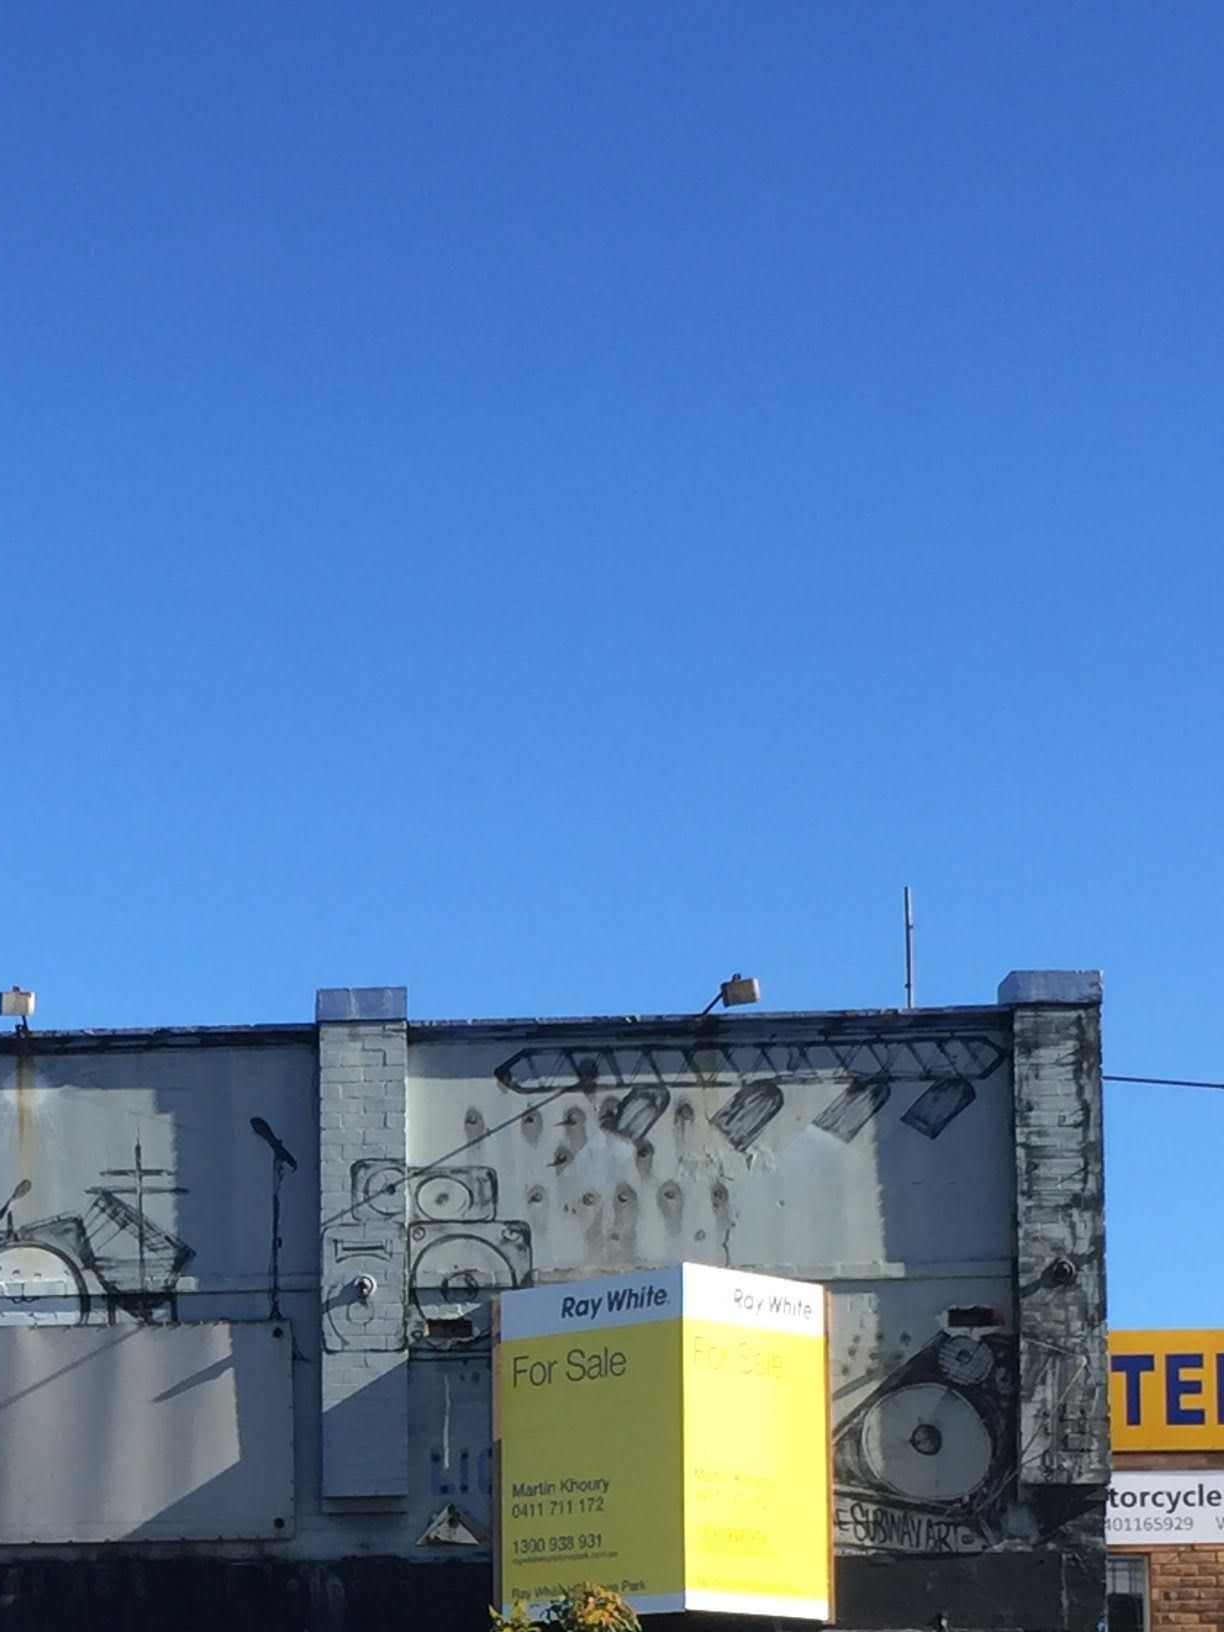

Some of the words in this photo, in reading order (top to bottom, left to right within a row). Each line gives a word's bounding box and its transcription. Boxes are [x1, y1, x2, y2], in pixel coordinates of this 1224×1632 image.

[561, 1295, 601, 1320] Ray
[607, 1285, 668, 1313] White
[733, 1288, 764, 1316] Ray
[768, 1294, 813, 1320] White
[512, 1355, 555, 1389] For
[565, 1346, 628, 1382] Sale
[512, 1481, 556, 1499] Martin
[559, 1477, 610, 1495] Khoury
[511, 1502, 543, 1519] 0411
[549, 1499, 573, 1516] 711
[579, 1496, 605, 1513] 172
[512, 1538, 545, 1555] 1300
[549, 1535, 575, 1552] 938
[577, 1533, 603, 1549] 931
